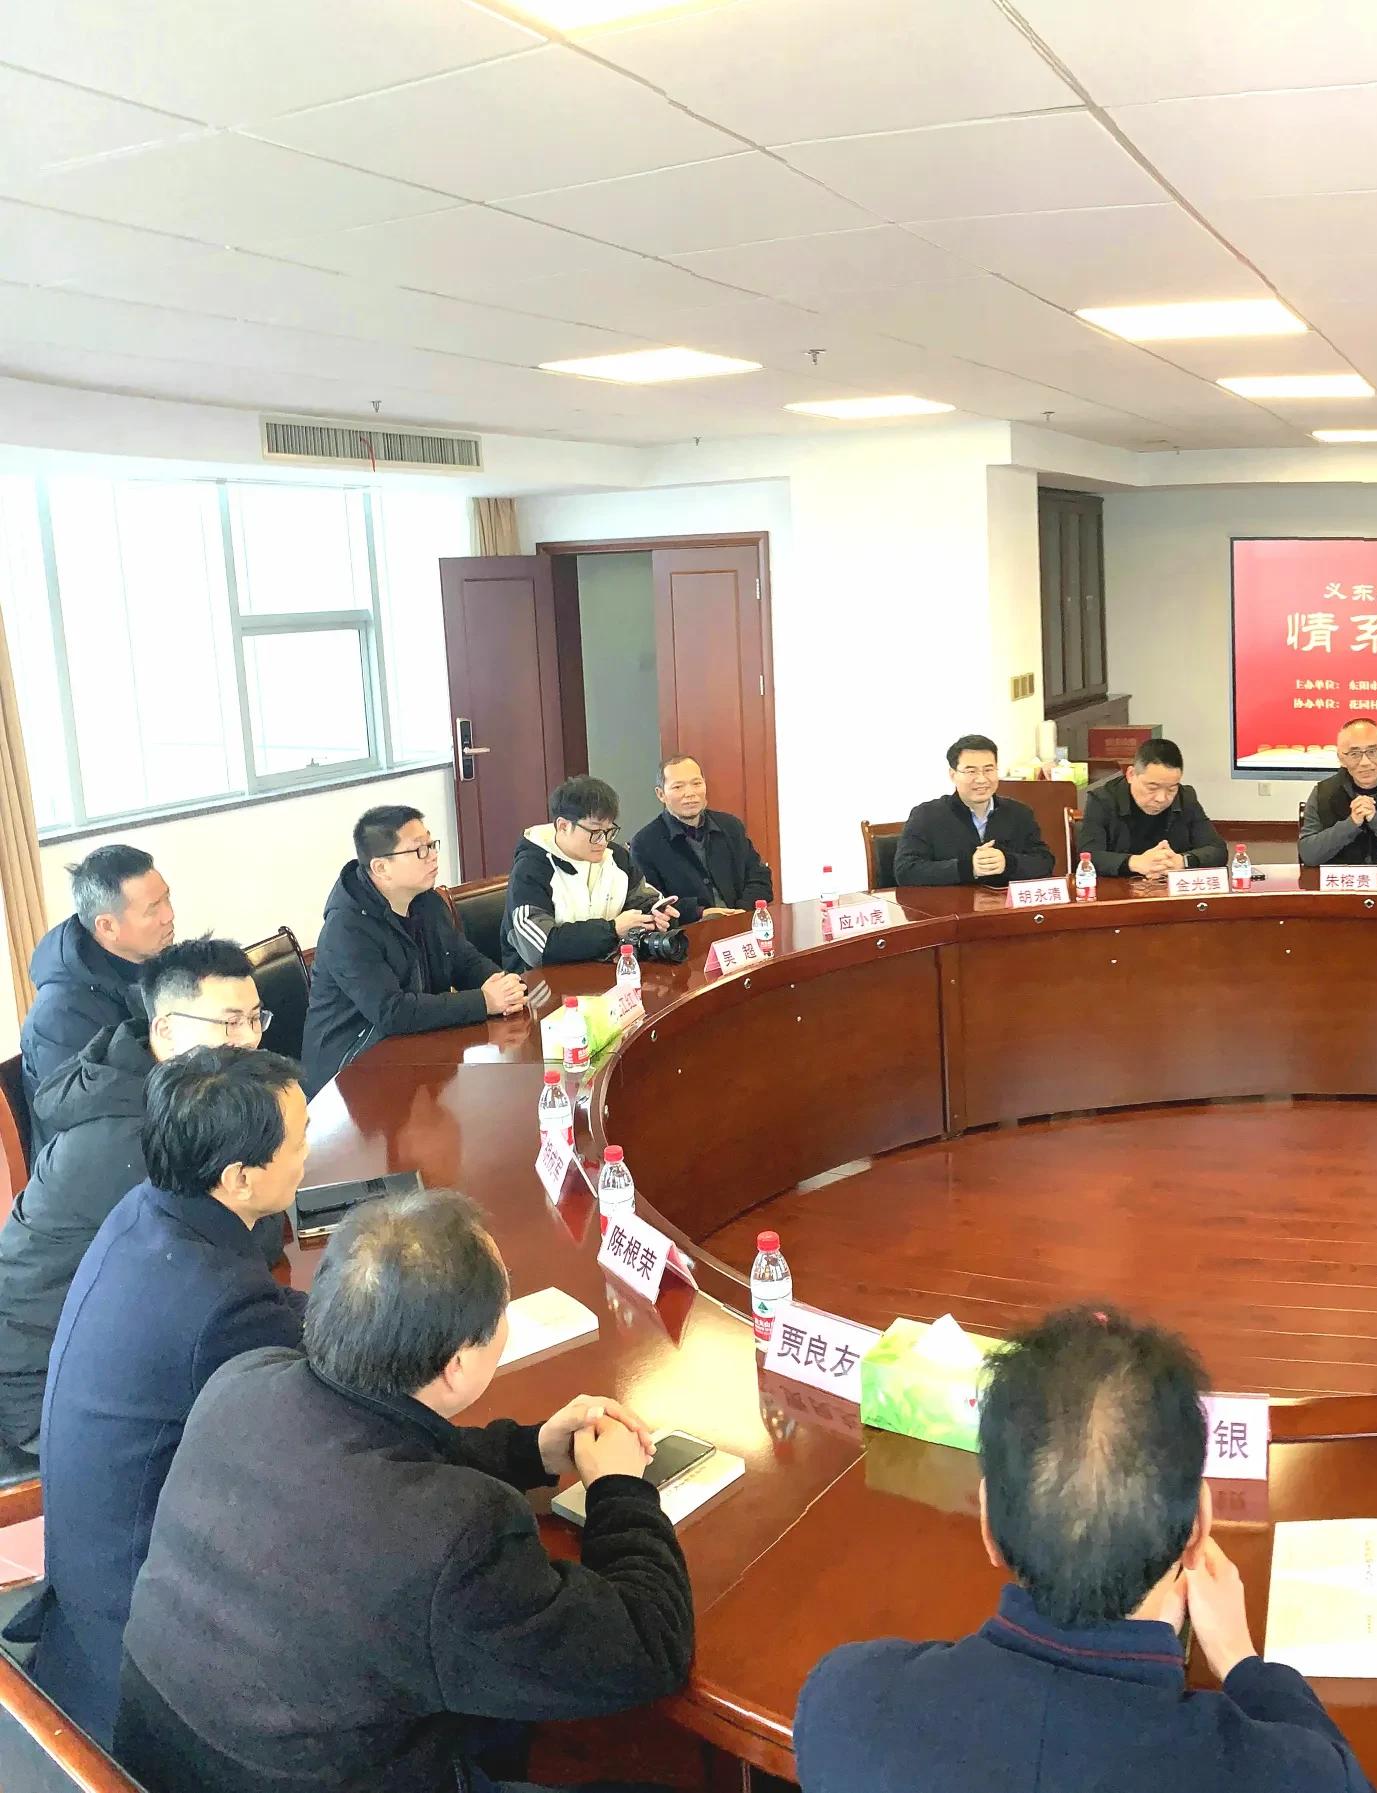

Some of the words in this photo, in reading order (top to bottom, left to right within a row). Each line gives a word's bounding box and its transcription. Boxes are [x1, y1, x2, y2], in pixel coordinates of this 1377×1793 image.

[1175, 876, 1222, 891] 金光强
[1325, 874, 1371, 888] 朱榕贵
[1018, 887, 1063, 904] 胡永清
[839, 908, 885, 931] 应小虎
[607, 1224, 658, 1281] 陈根荣
[776, 1323, 861, 1378] 贾良友
